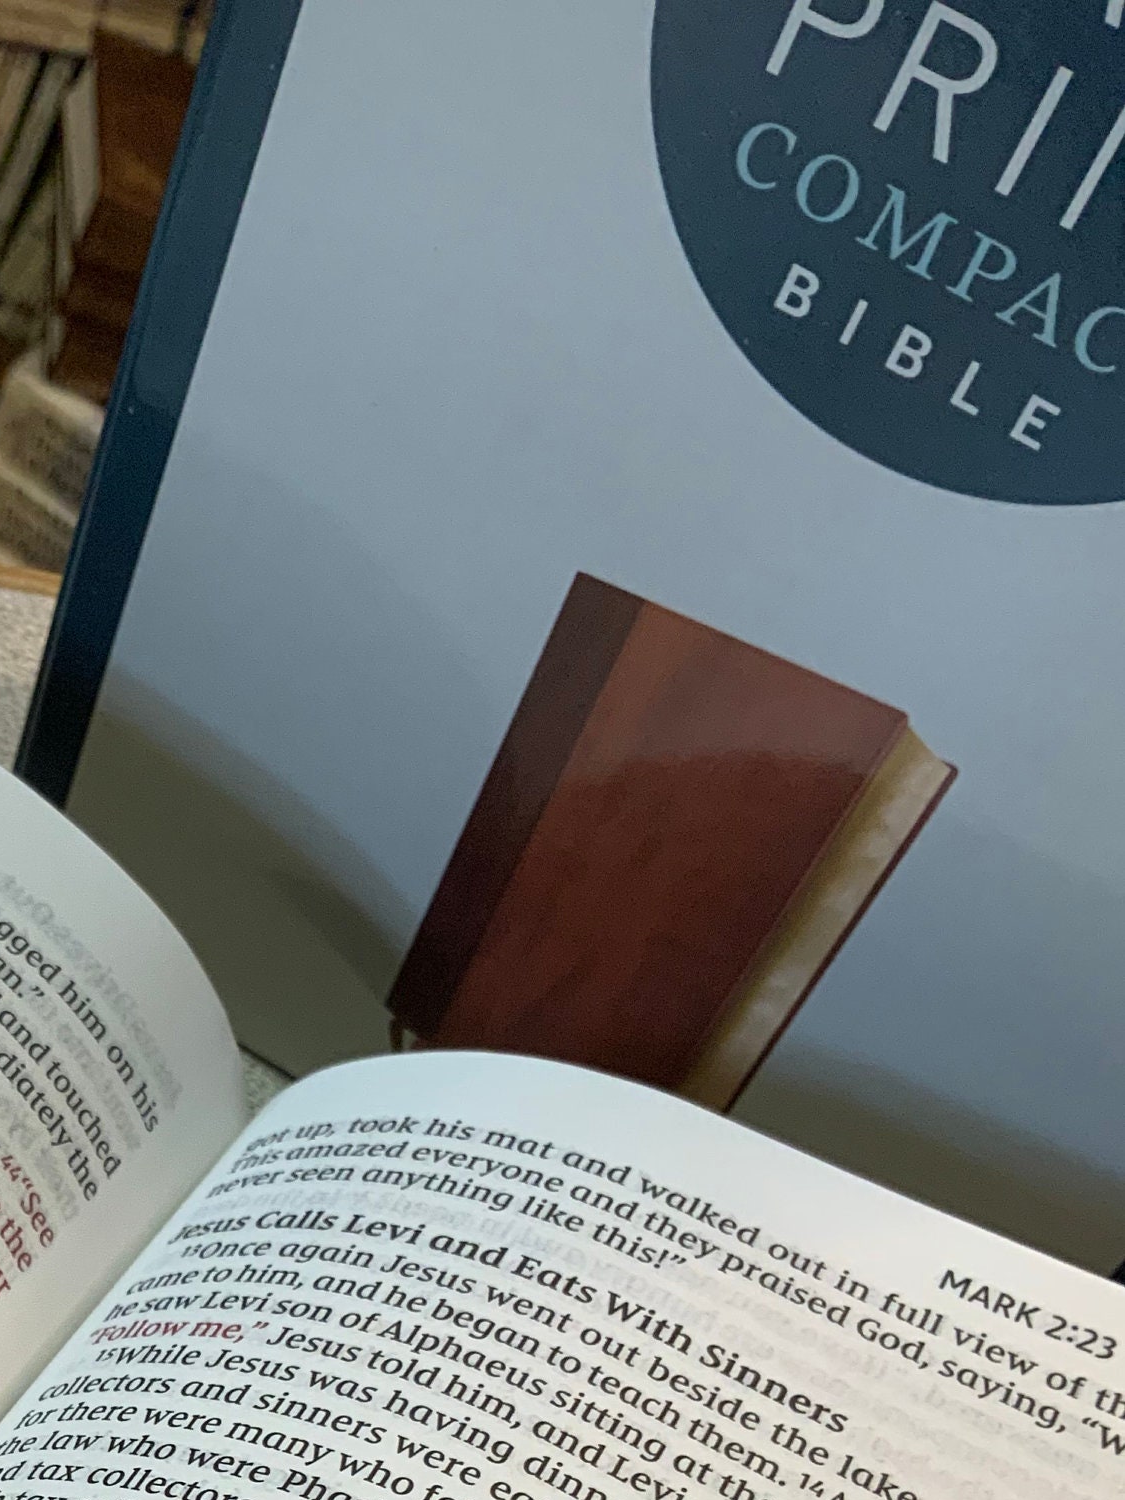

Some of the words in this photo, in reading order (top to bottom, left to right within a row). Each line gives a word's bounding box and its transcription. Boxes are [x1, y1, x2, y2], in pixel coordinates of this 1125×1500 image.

[774, 263, 1061, 451] BIBLE
[67, 1148, 98, 1202] the
[0, 1218, 33, 1273] the
[167, 1215, 251, 1246] Jesus
[255, 1209, 340, 1231] Calls
[341, 1213, 427, 1246] Levi
[428, 1234, 509, 1269] and
[510, 1254, 597, 1304] Eats
[607, 1290, 693, 1356] With
[698, 1343, 849, 1433] Sinners
[938, 1269, 1042, 1329] MARK
[1044, 1314, 1118, 1360] 2:23
[13, 1408, 59, 1431] for
[56, 1401, 138, 1423] there
[143, 1407, 223, 1434] were
[224, 1421, 336, 1467] many
[339, 1452, 415, 1496] who
